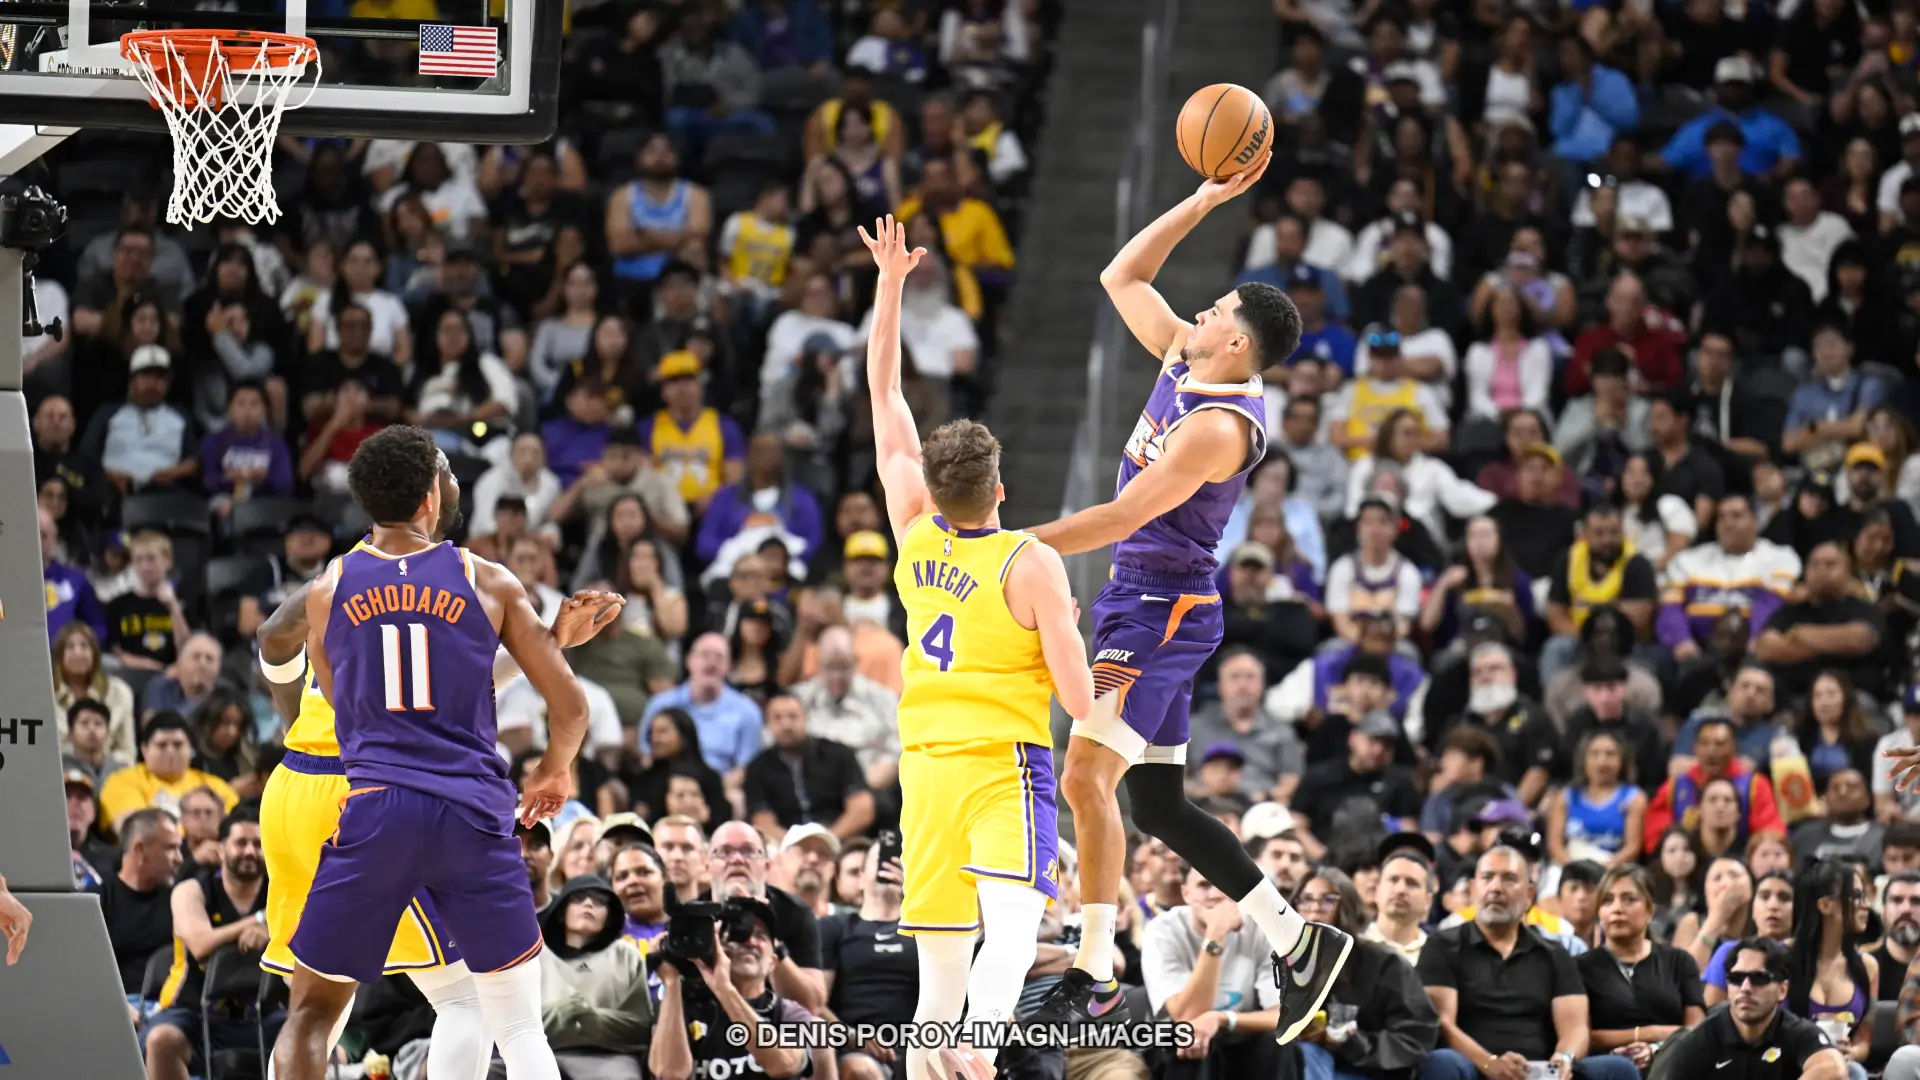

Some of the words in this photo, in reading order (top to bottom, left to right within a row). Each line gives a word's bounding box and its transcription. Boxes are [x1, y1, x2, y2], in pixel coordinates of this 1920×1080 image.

[1234, 108, 1269, 165] Wilson
[342, 583, 467, 627] IGHODARO
[912, 559, 979, 603] KNECHT
[920, 611, 955, 672] 4
[1094, 648, 1135, 663] ENIX
[379, 622, 436, 712] 11
